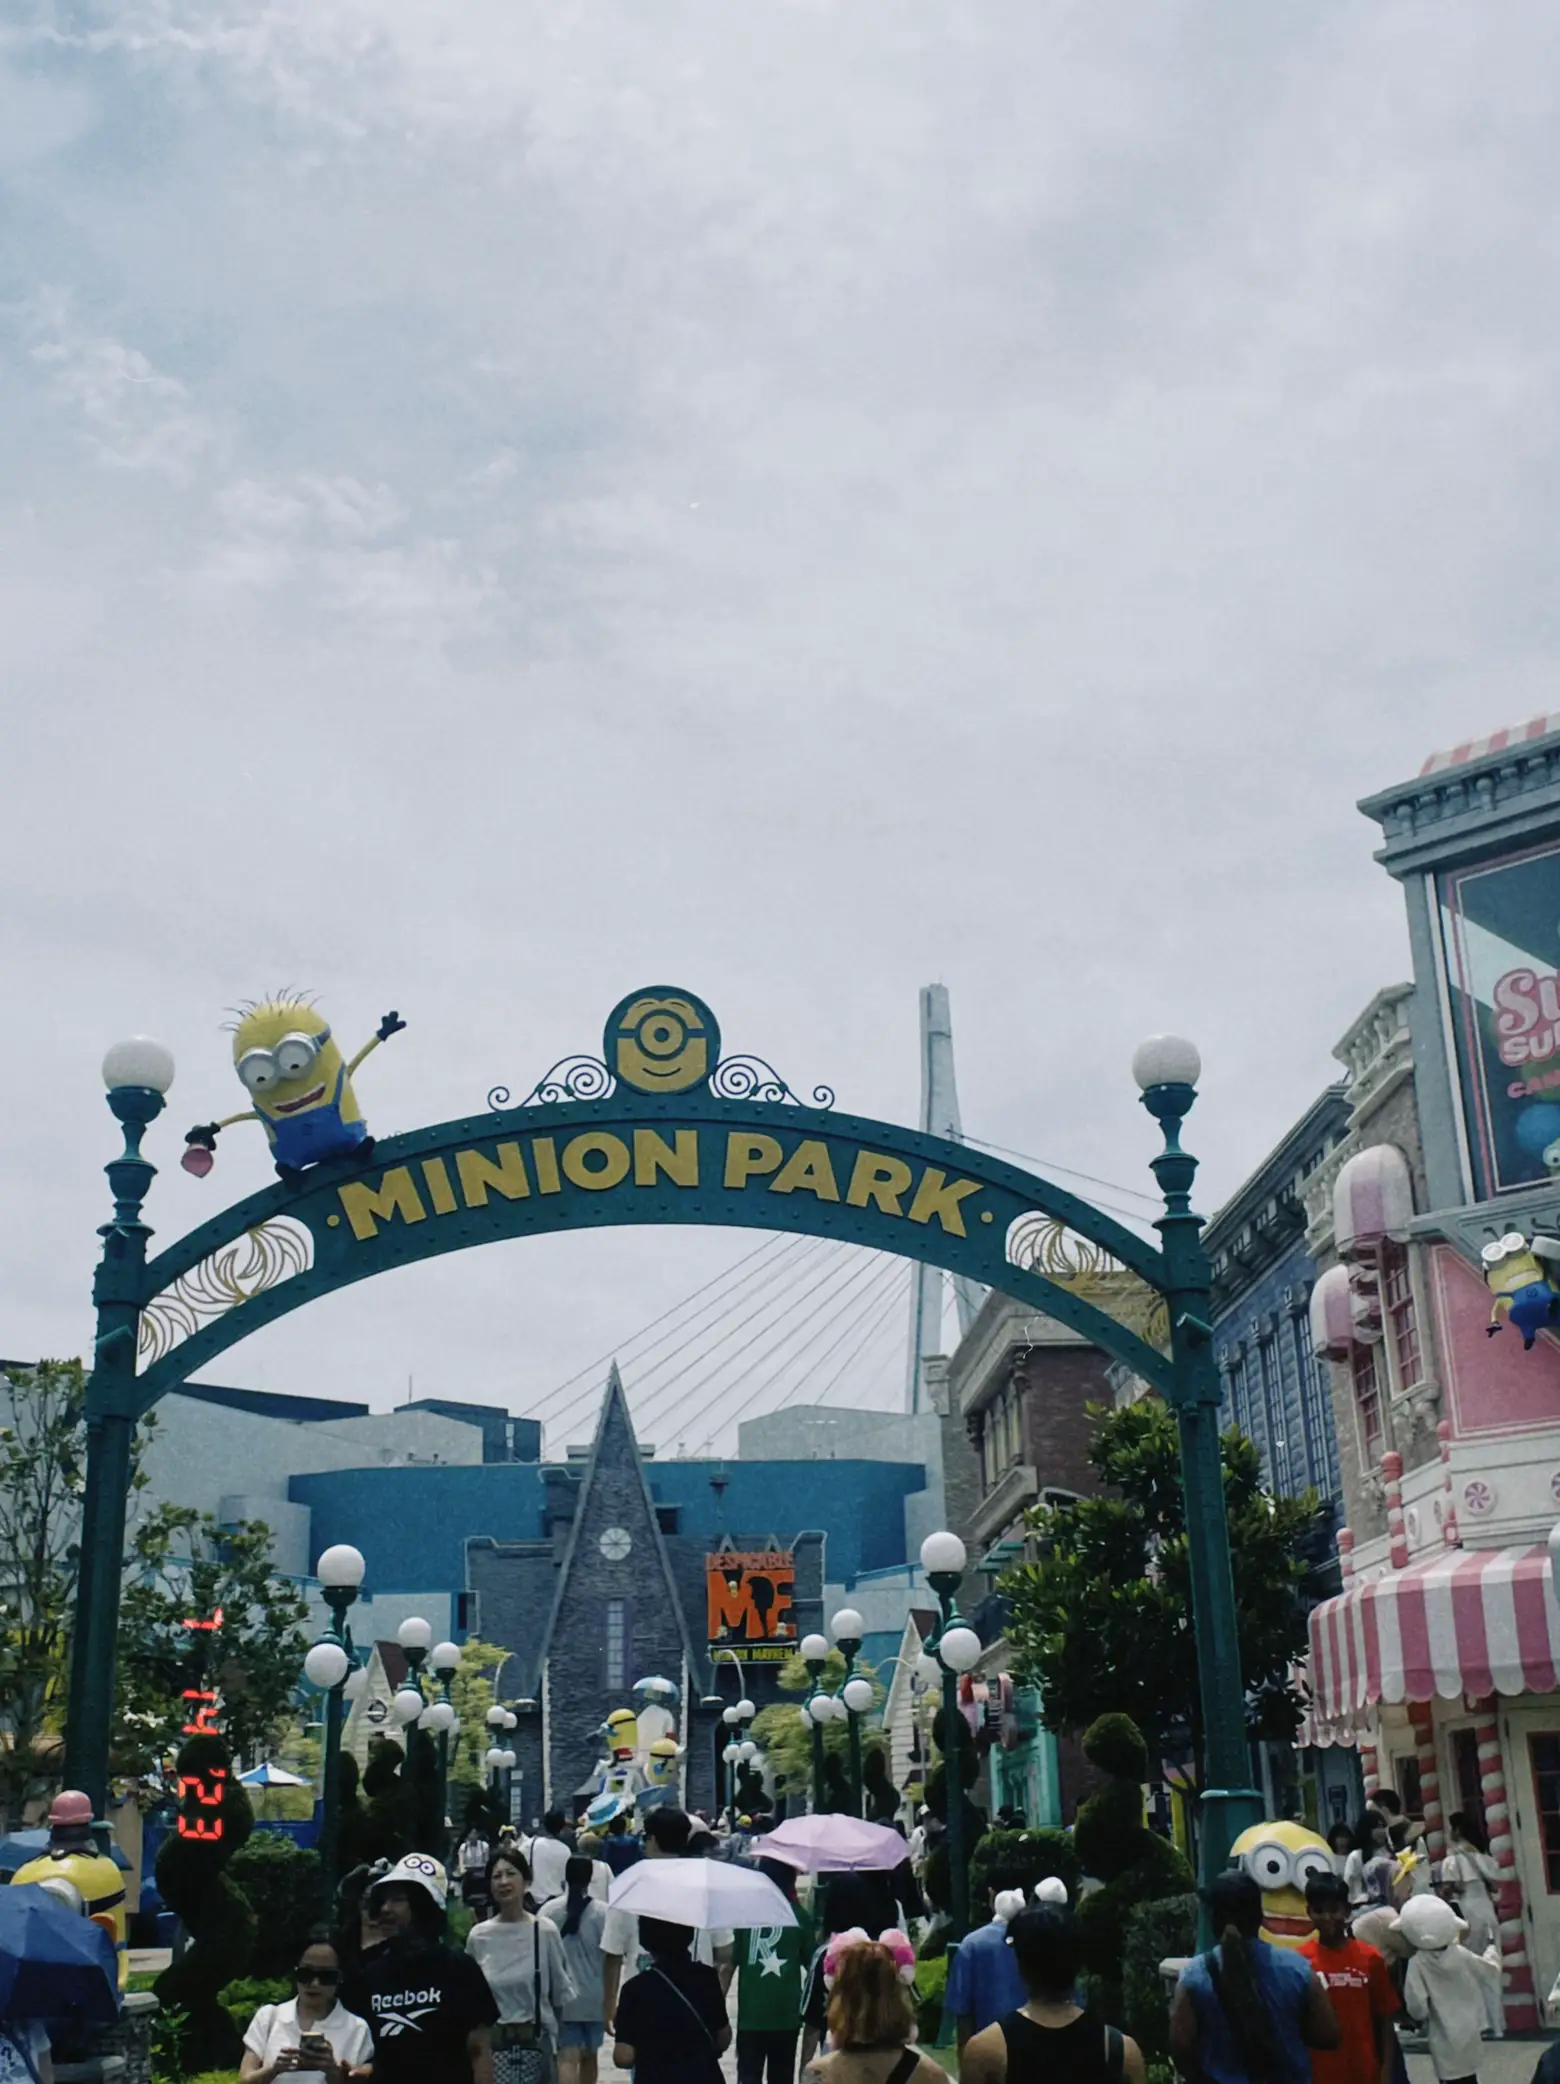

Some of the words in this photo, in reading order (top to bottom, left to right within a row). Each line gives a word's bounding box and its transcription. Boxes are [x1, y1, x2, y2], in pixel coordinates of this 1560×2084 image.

[338, 1129, 699, 1241] MINION
[723, 1131, 984, 1238] PARK
[707, 1569, 797, 1640] ME
[371, 1987, 441, 2013] Reebok
